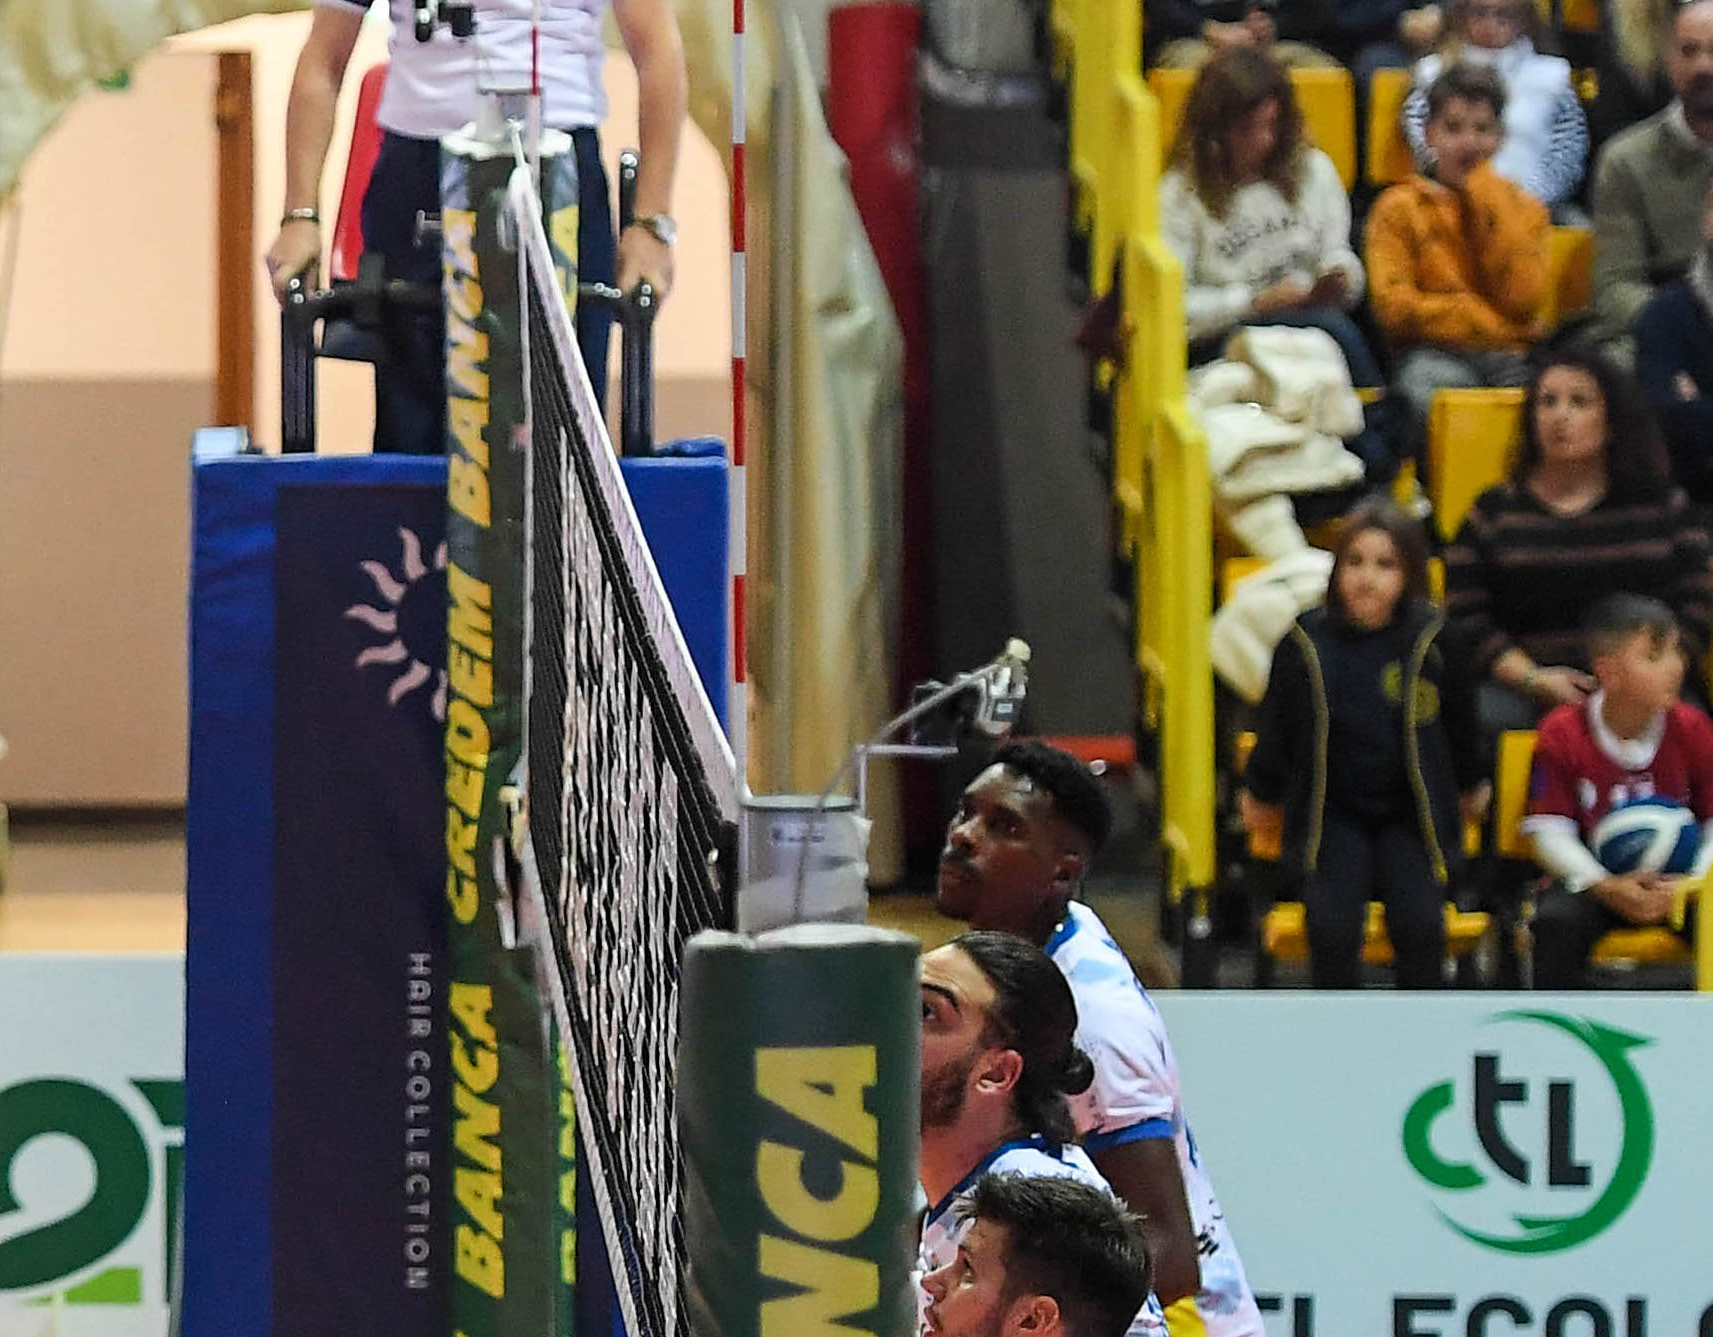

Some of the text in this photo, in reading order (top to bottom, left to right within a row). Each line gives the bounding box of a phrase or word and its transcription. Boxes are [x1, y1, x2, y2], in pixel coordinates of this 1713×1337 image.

[442, 209, 494, 924] CREDEM BANCA
[402, 952, 432, 1290] HAIR COLLECTION
[449, 983, 505, 1298] BANCA
